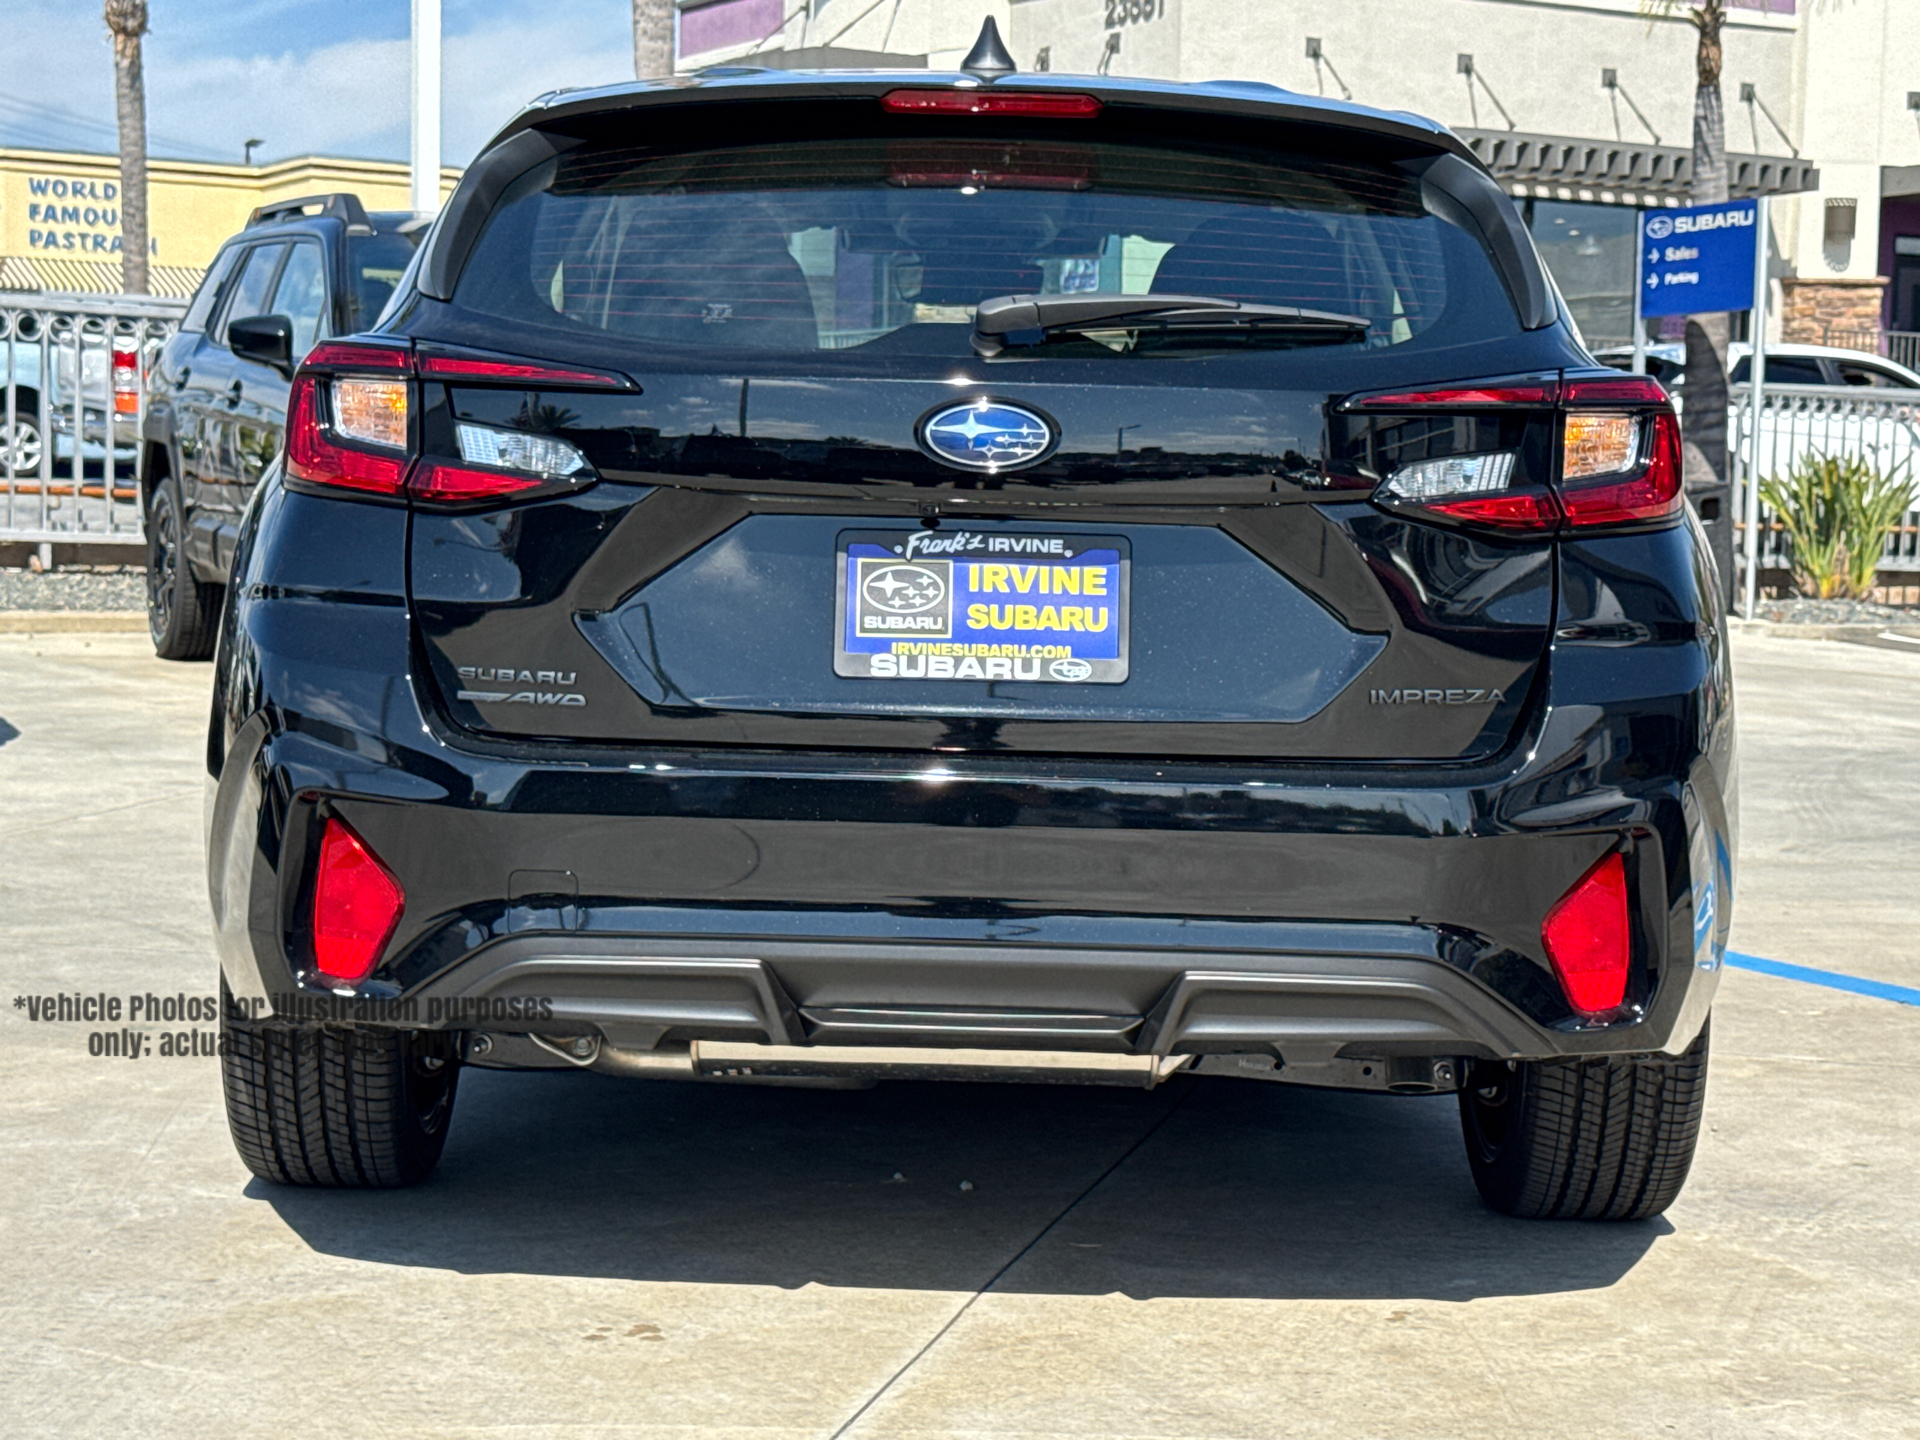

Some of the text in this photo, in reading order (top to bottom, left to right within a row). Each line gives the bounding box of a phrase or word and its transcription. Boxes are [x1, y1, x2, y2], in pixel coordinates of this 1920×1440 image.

[29, 177, 118, 201] WORLD
[29, 203, 121, 227] FAMOU
[1674, 209, 1755, 234] SUBARU
[29, 229, 157, 256] PASTRAI
[1664, 246, 1699, 261] Sales
[906, 530, 1064, 560] Frank's IRVINE
[968, 564, 1108, 595] IRVINE
[864, 615, 942, 629] SUBARU
[966, 603, 1109, 632] SUBARU
[891, 642, 1071, 659] IRVINESUBARU.COM
[457, 666, 577, 685] SUBARU
[870, 653, 1041, 680] SUBARU
[507, 691, 587, 706] AWD
[1370, 688, 1506, 704] IMPREZA
